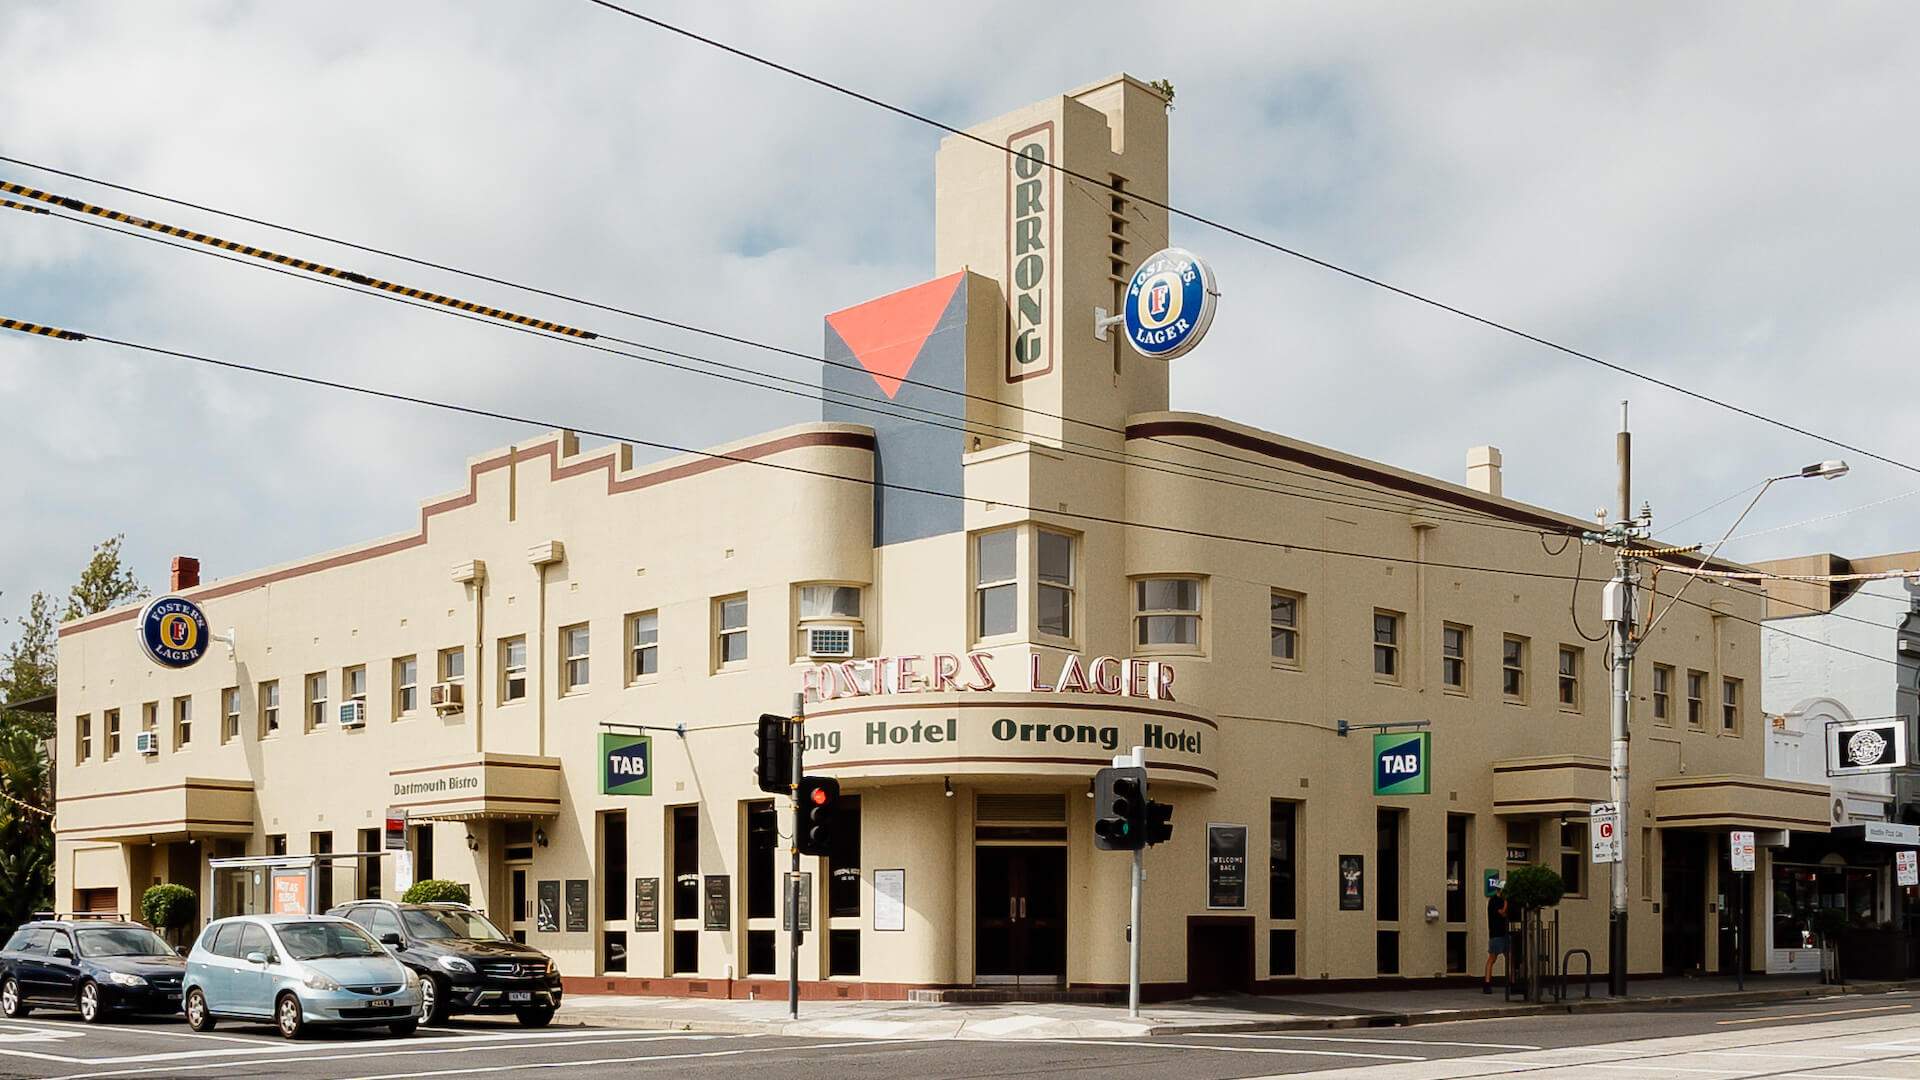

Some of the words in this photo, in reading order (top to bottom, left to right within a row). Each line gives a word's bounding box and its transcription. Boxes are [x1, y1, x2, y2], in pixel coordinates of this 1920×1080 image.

[1015, 143, 1045, 364] ORRONG
[1131, 259, 1196, 296] FOSTR'S
[1136, 318, 1190, 344] LAGER
[155, 644, 199, 660] LAGER
[803, 651, 996, 704] FOSTERS
[1031, 653, 1176, 701] LAGER
[866, 718, 957, 745] Hotel
[992, 718, 1119, 751] Orrong
[1144, 723, 1201, 754] Hotel
[610, 756, 645, 775] TAB
[1381, 755, 1418, 774] TAB
[393, 779, 446, 795] Dartmouth
[449, 776, 478, 790] Bistro
